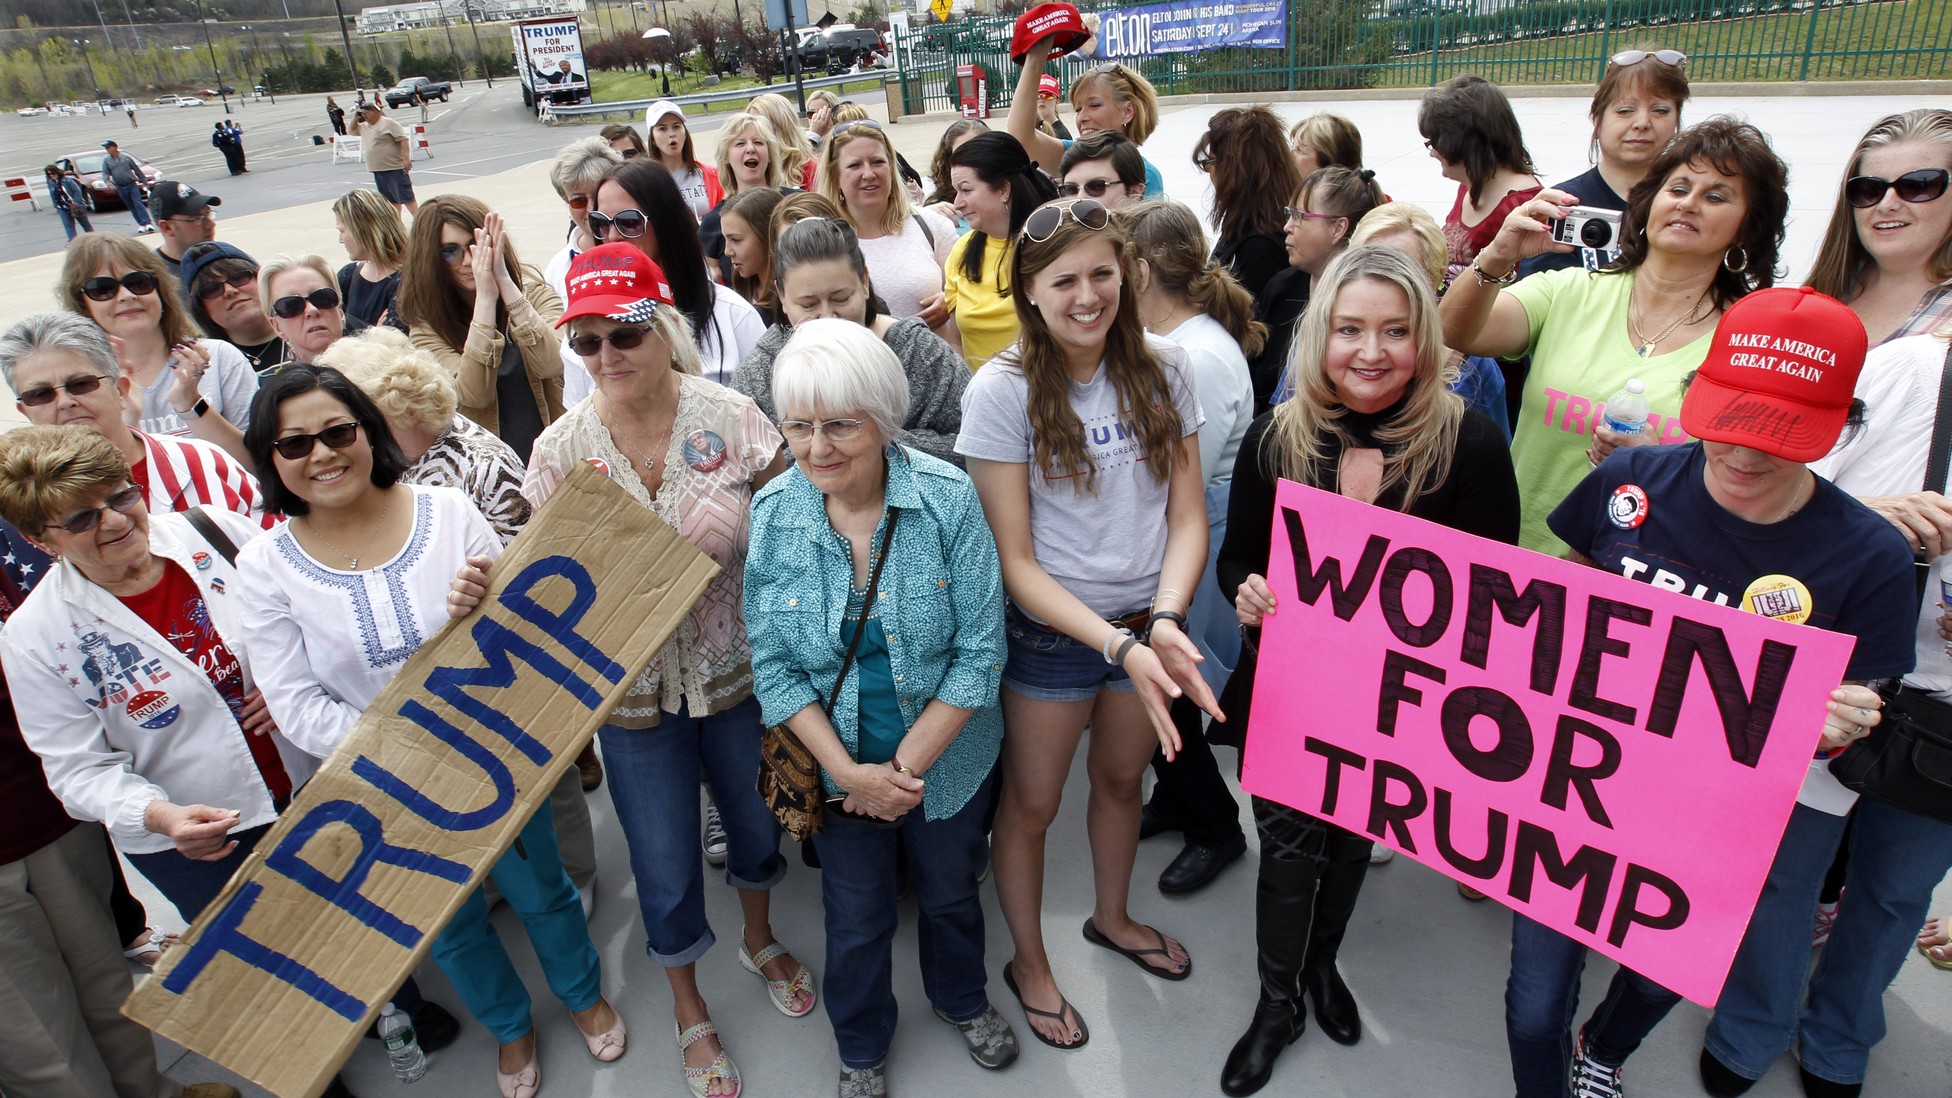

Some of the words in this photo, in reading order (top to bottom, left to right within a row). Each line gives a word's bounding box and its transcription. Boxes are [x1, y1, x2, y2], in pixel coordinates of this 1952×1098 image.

[1026, 17, 1044, 29] MAKE
[1043, 9, 1070, 21] AMERICA
[1152, 11, 1171, 23] ELTON
[1173, 9, 1191, 21] JOHN
[1200, 7, 1213, 18] HIS
[1214, 4, 1234, 17] BAND
[525, 25, 577, 38] TRUMP
[1032, 22, 1051, 34] GREAT
[1050, 17, 1069, 26] AGAIN
[1106, 13, 1151, 57] elton
[1152, 26, 1191, 42] SATURDAY
[1196, 24, 1216, 39] SEPT
[1218, 22, 1229, 36] 24
[533, 45, 575, 54] PRESIDENT
[545, 38, 560, 46] FOR
[601, 269, 619, 277] GREAT
[619, 269, 636, 279] AGAIN
[1728, 333, 1770, 348] MAKE
[1770, 337, 1836, 367] AMERICA
[1730, 353, 1777, 370] GREAT
[1776, 360, 1823, 383] AGAIN
[1113, 443, 1139, 456] GREAT
[700, 453, 721, 467] TRUMP
[1627, 485, 1645, 500] TRUMP
[1282, 508, 1796, 769] WOMEN
[85, 657, 171, 710] VOTE
[128, 696, 169, 722] TRUMP
[1378, 650, 1621, 829] FOR
[163, 556, 625, 1022] TRUMP
[1306, 737, 1690, 949] TRUMP
